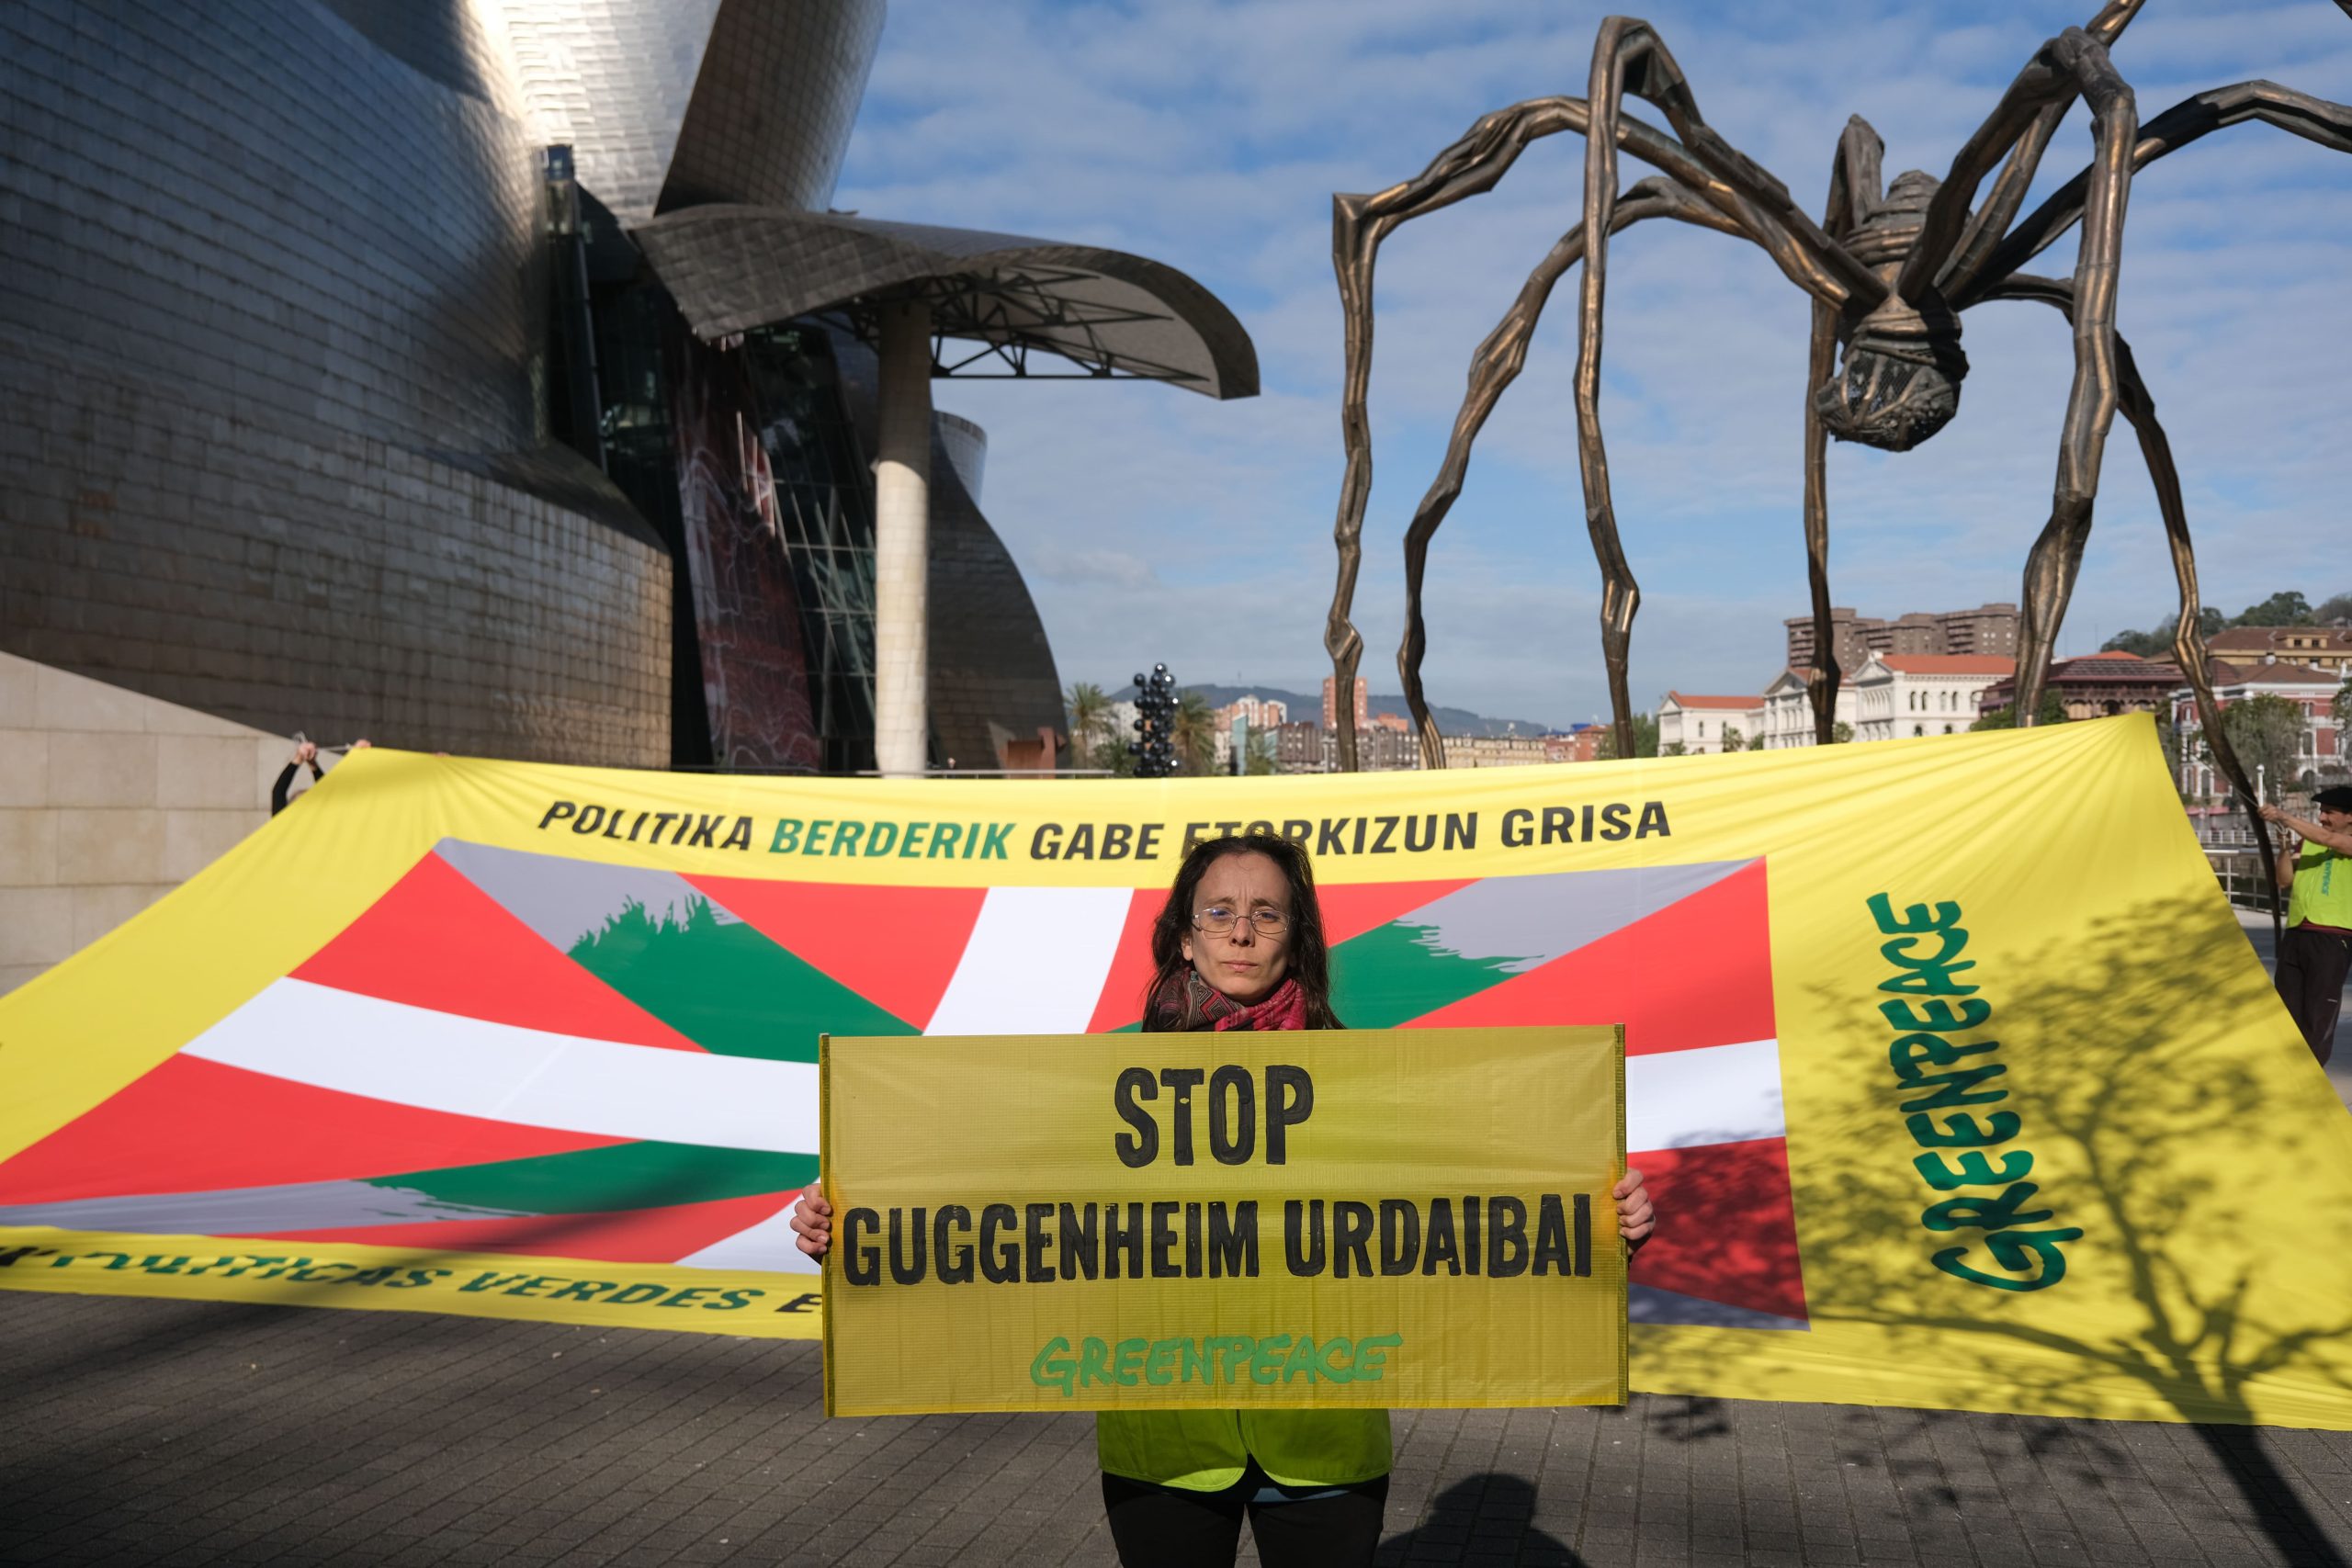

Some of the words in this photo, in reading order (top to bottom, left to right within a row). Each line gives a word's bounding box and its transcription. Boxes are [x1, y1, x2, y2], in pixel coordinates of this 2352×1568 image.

[537, 800, 753, 851] POLITIKA
[768, 818, 1017, 860] BERDERIK
[1030, 822, 1168, 861] GABE
[1500, 800, 1672, 848] GRISA
[1114, 1064, 1315, 1168] STOP
[1866, 892, 2085, 1292] GREENPEACE
[842, 1200, 1260, 1286] GUGGENHEIM
[1283, 1193, 1592, 1279] URDAIBAI
[459, 1271, 765, 1311] VERDES
[1029, 1332, 1403, 1398] GREENPEACE
